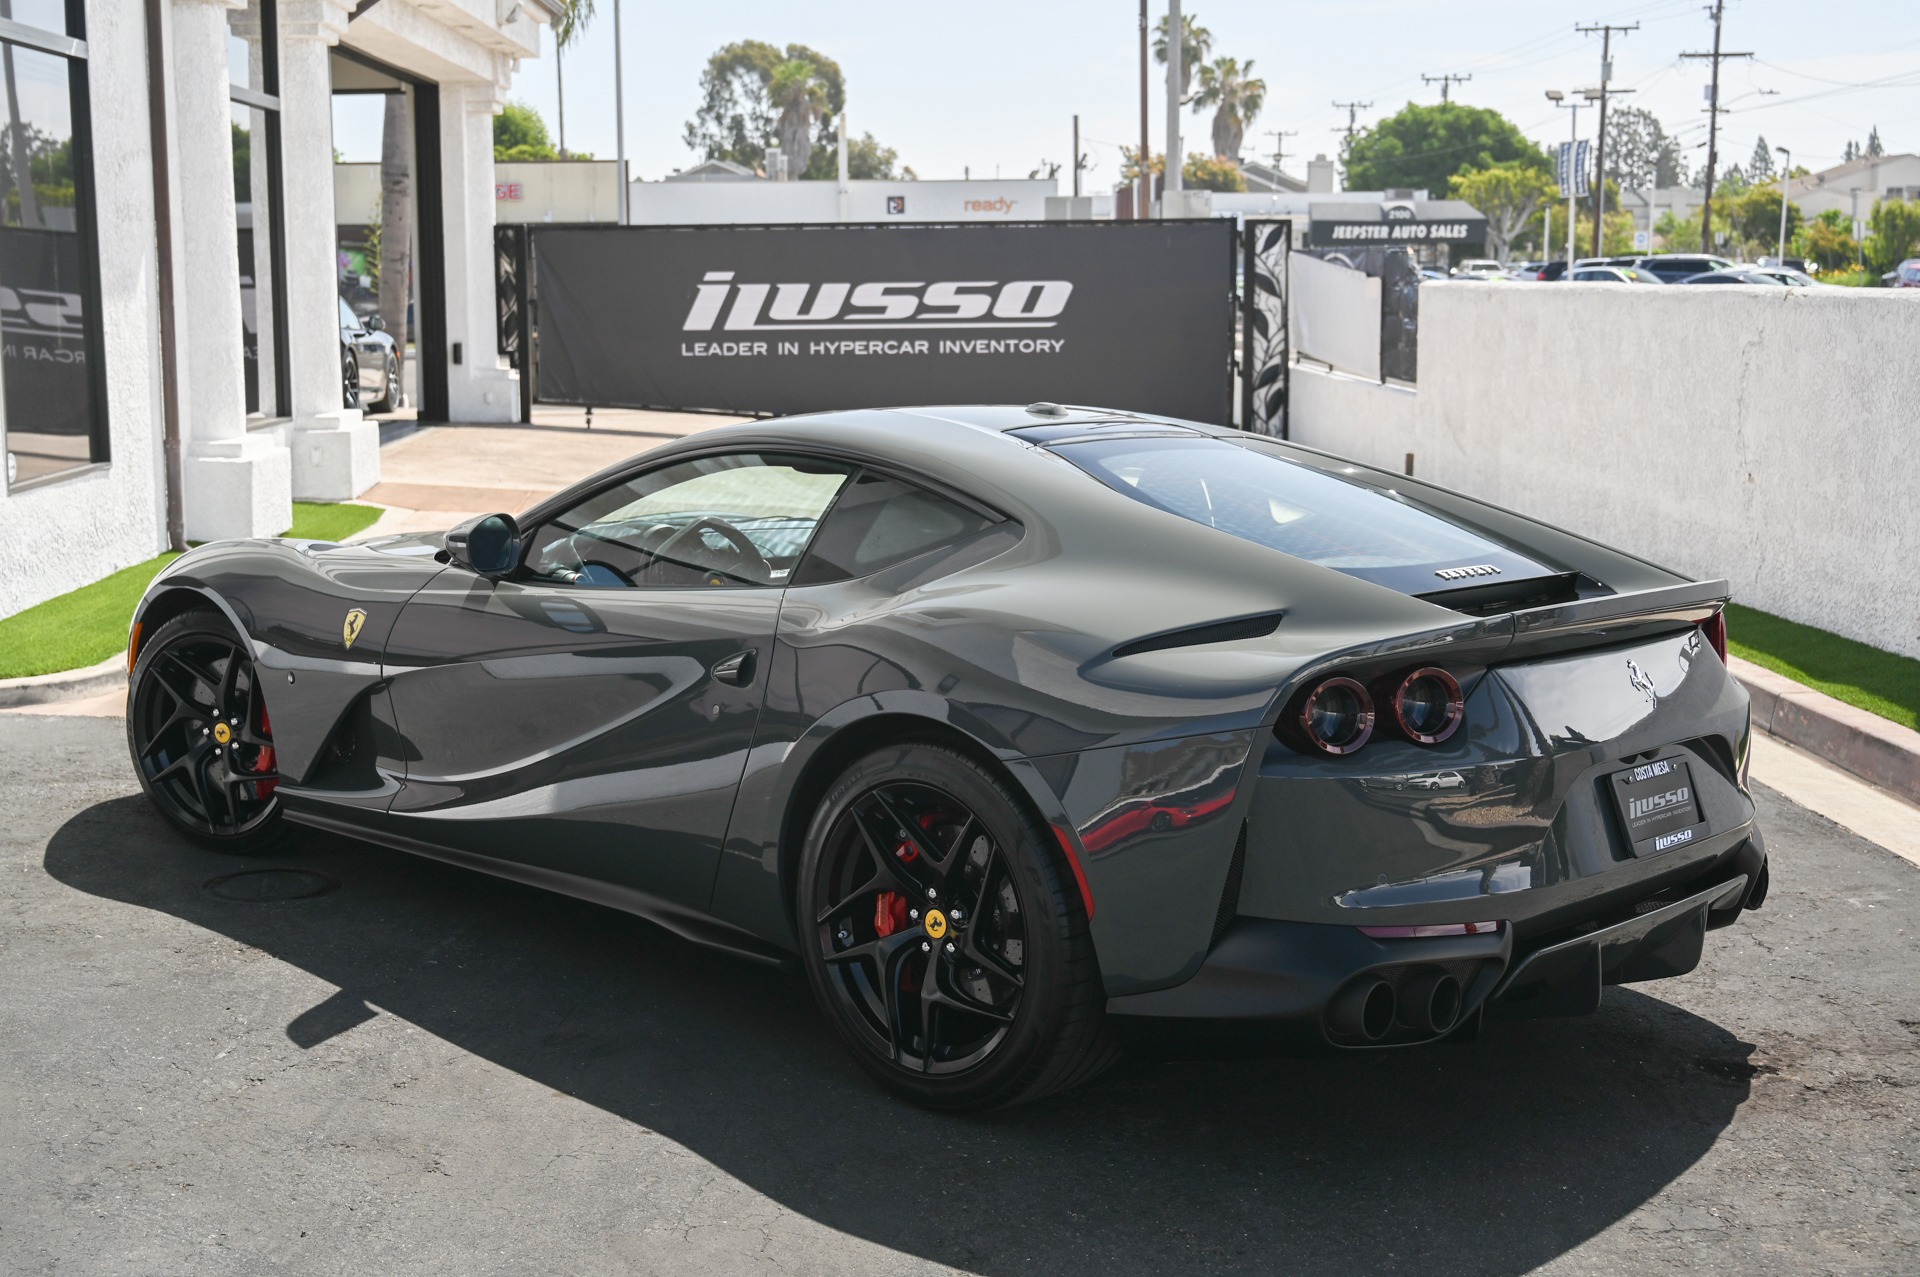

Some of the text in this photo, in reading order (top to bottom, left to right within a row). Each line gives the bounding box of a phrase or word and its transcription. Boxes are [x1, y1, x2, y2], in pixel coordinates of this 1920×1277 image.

[964, 197, 1014, 214] ready
[1389, 209, 1412, 219] 2100
[1332, 224, 1468, 239] JEEPSTER AUTO SALES
[681, 339, 1065, 356] LEADER IN HYPERCAR INVENTORY
[1634, 761, 1670, 781] COSTA MESA
